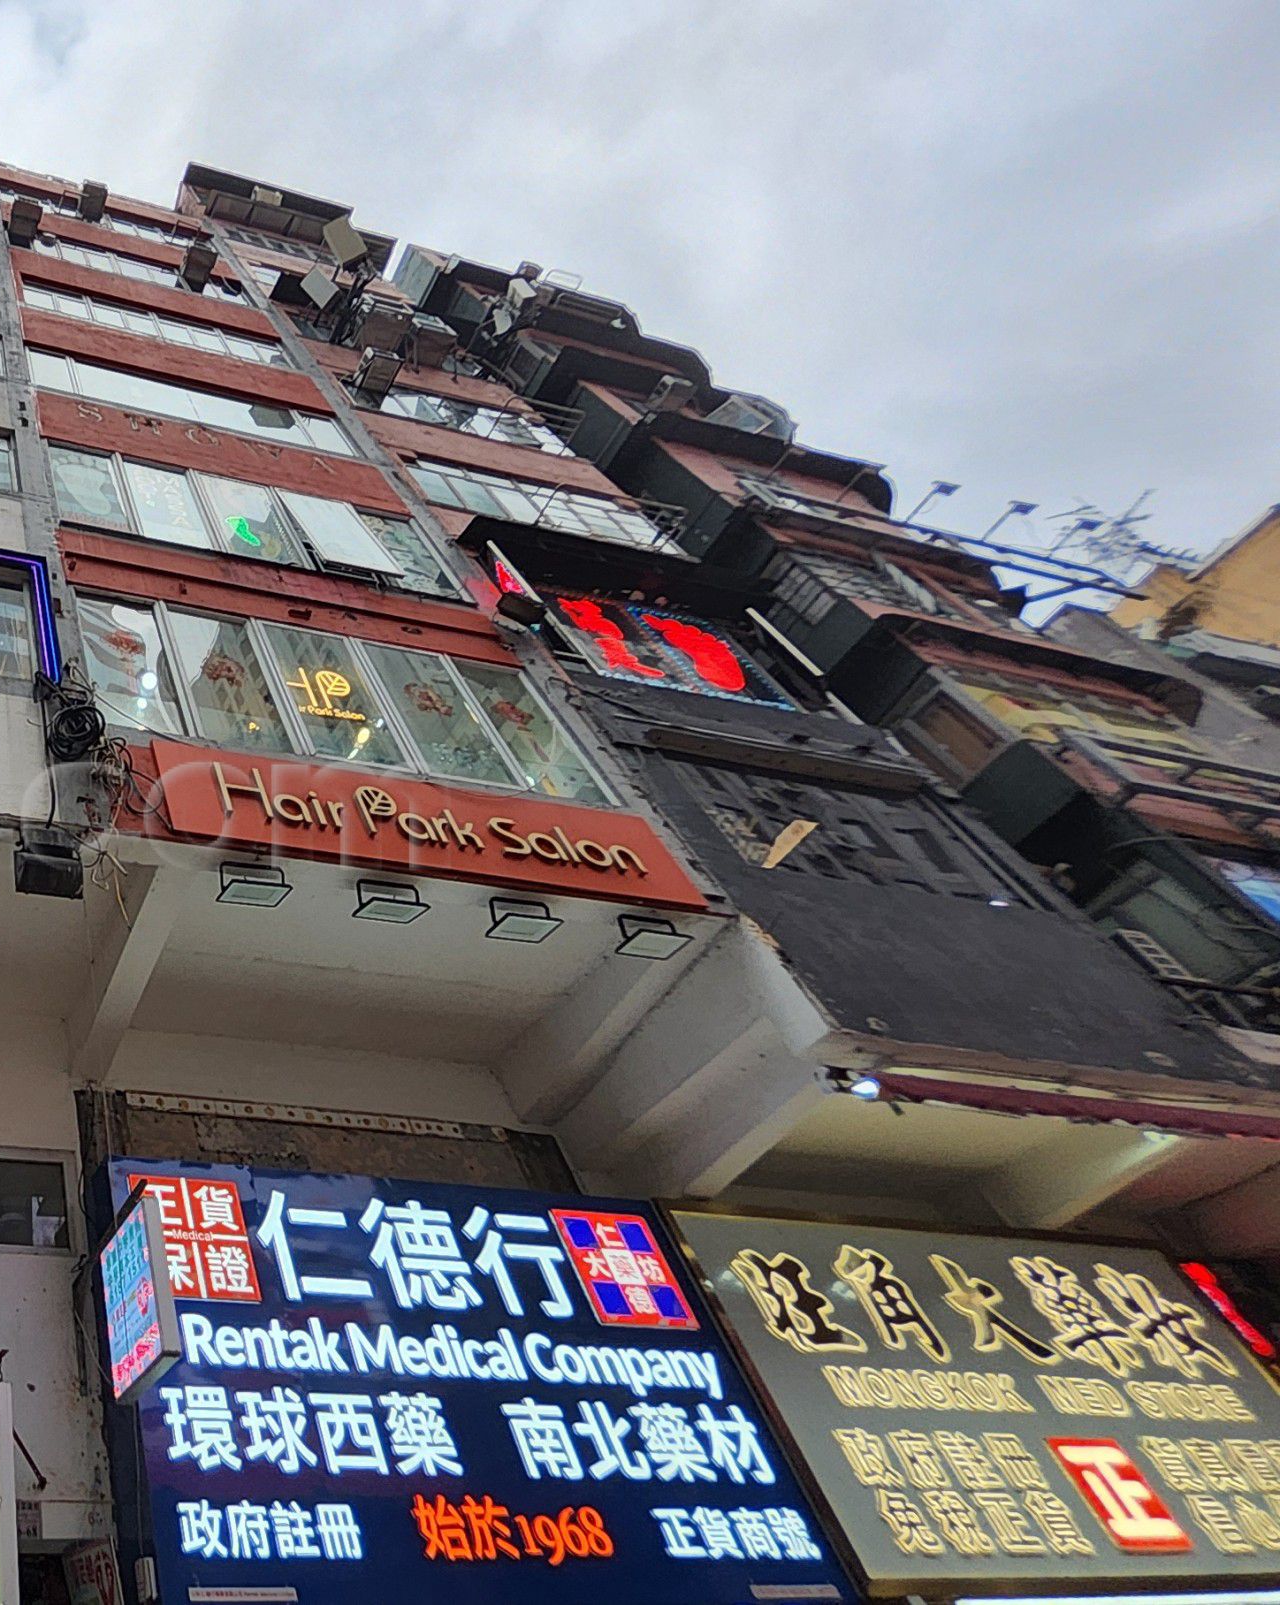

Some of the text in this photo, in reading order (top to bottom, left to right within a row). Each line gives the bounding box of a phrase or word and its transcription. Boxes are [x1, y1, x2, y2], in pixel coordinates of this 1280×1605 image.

[307, 706, 334, 718] Park
[334, 708, 367, 722] Salon
[212, 761, 649, 876] Hair Park Salon
[171, 1228, 215, 1242] Medical
[256, 1189, 576, 1320] 仁德行
[178, 1312, 724, 1400] Rentak Medical Company
[819, 1364, 1038, 1416] MONGKOK
[1124, 1380, 1259, 1423] STORE
[158, 1384, 778, 1486] 環球西藥 南北藥材
[832, 1426, 1052, 1492] 政府註冊
[1060, 1443, 1183, 1542] 正
[1184, 1493, 1280, 1556] 信心
[176, 1493, 824, 1568] 政府註冊 始於1968 正貨商號
